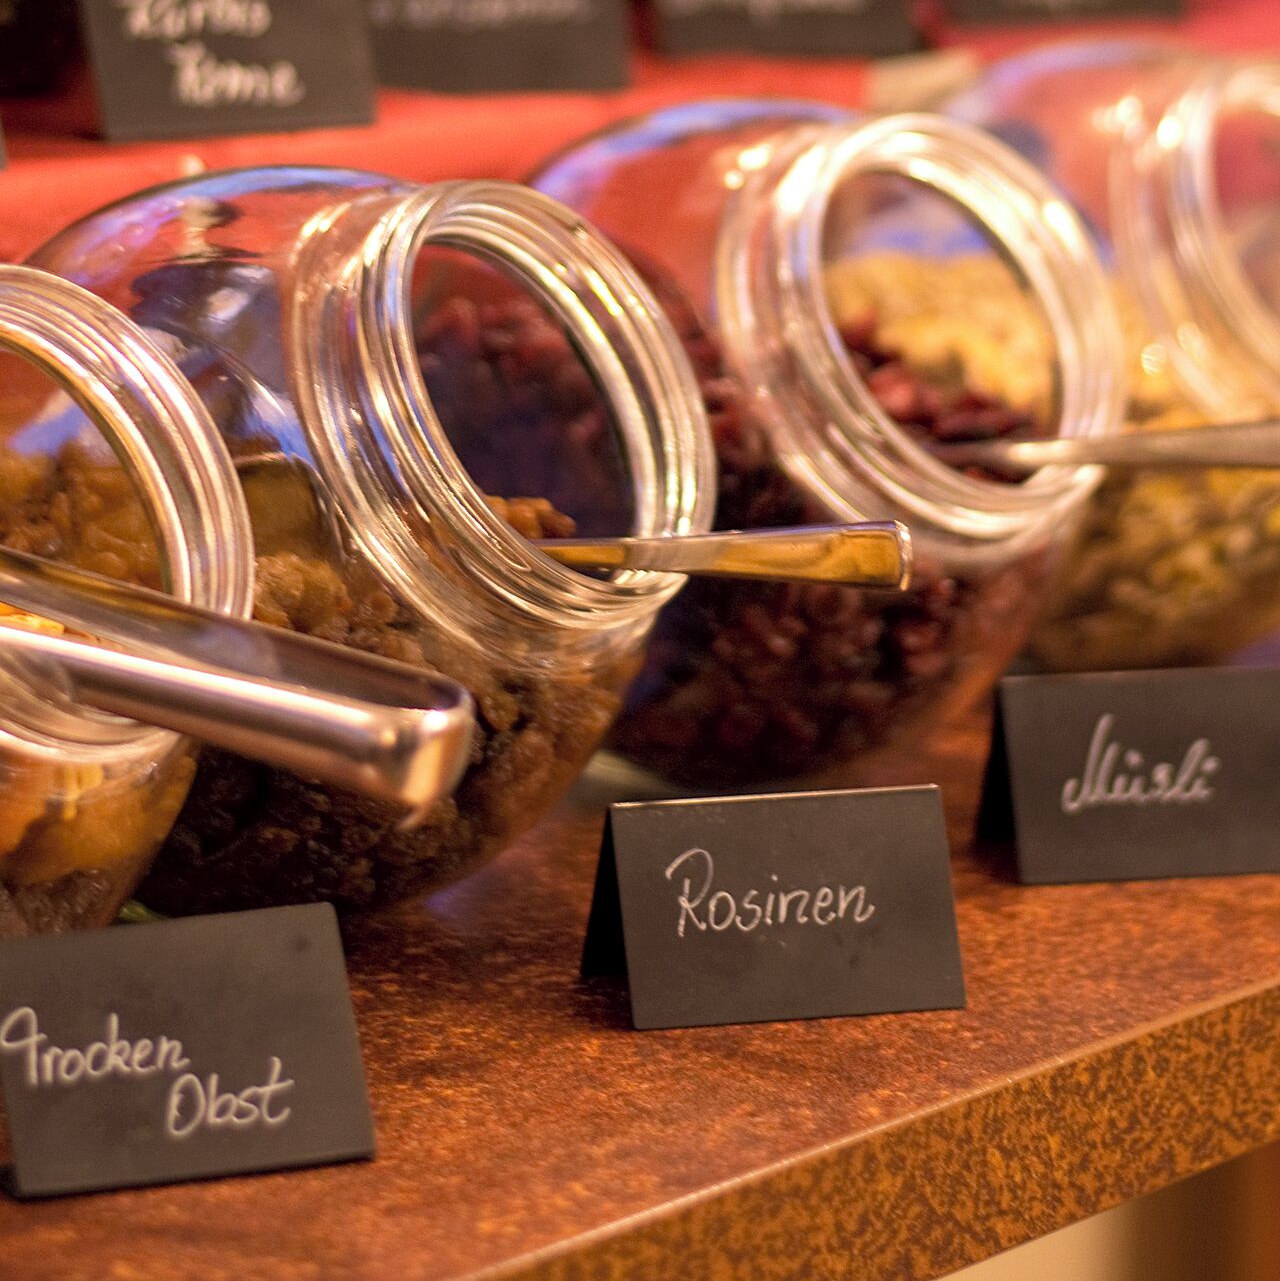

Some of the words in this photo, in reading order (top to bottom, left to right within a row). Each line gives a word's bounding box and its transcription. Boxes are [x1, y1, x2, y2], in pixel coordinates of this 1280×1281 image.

[1061, 713, 1219, 815] Müsli
[665, 848, 875, 938] Rosinen
[165, 1056, 295, 1139] Obst
